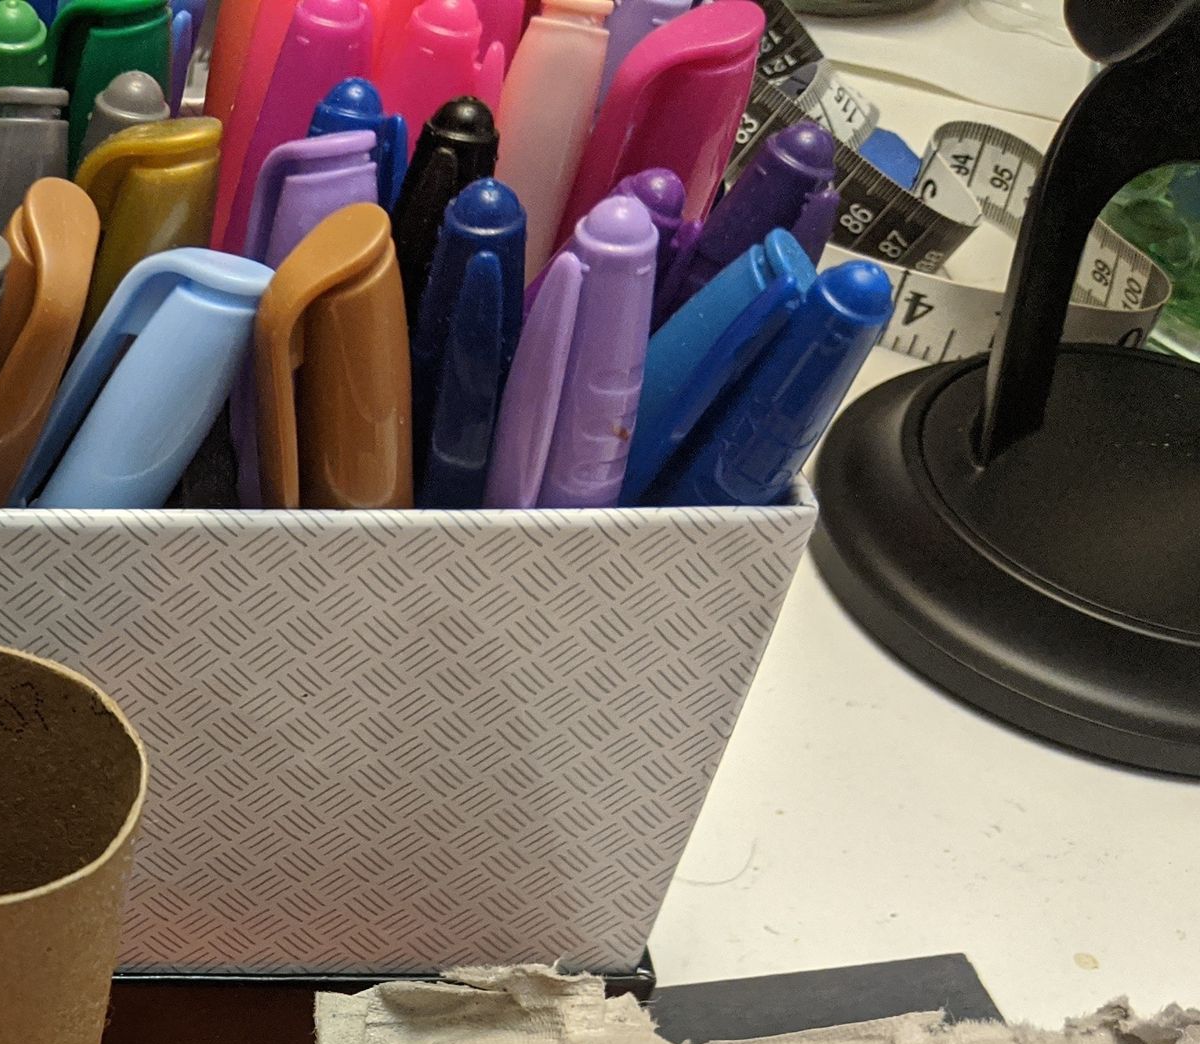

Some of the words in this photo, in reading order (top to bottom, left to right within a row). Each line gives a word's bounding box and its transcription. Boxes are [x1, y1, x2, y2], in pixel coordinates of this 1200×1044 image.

[833, 86, 857, 123] 115
[989, 164, 1014, 192] 95
[839, 203, 873, 234] 86
[878, 229, 908, 258] 87
[1091, 258, 1112, 287] 99
[901, 290, 935, 327] 4
[1121, 277, 1143, 310] 100
